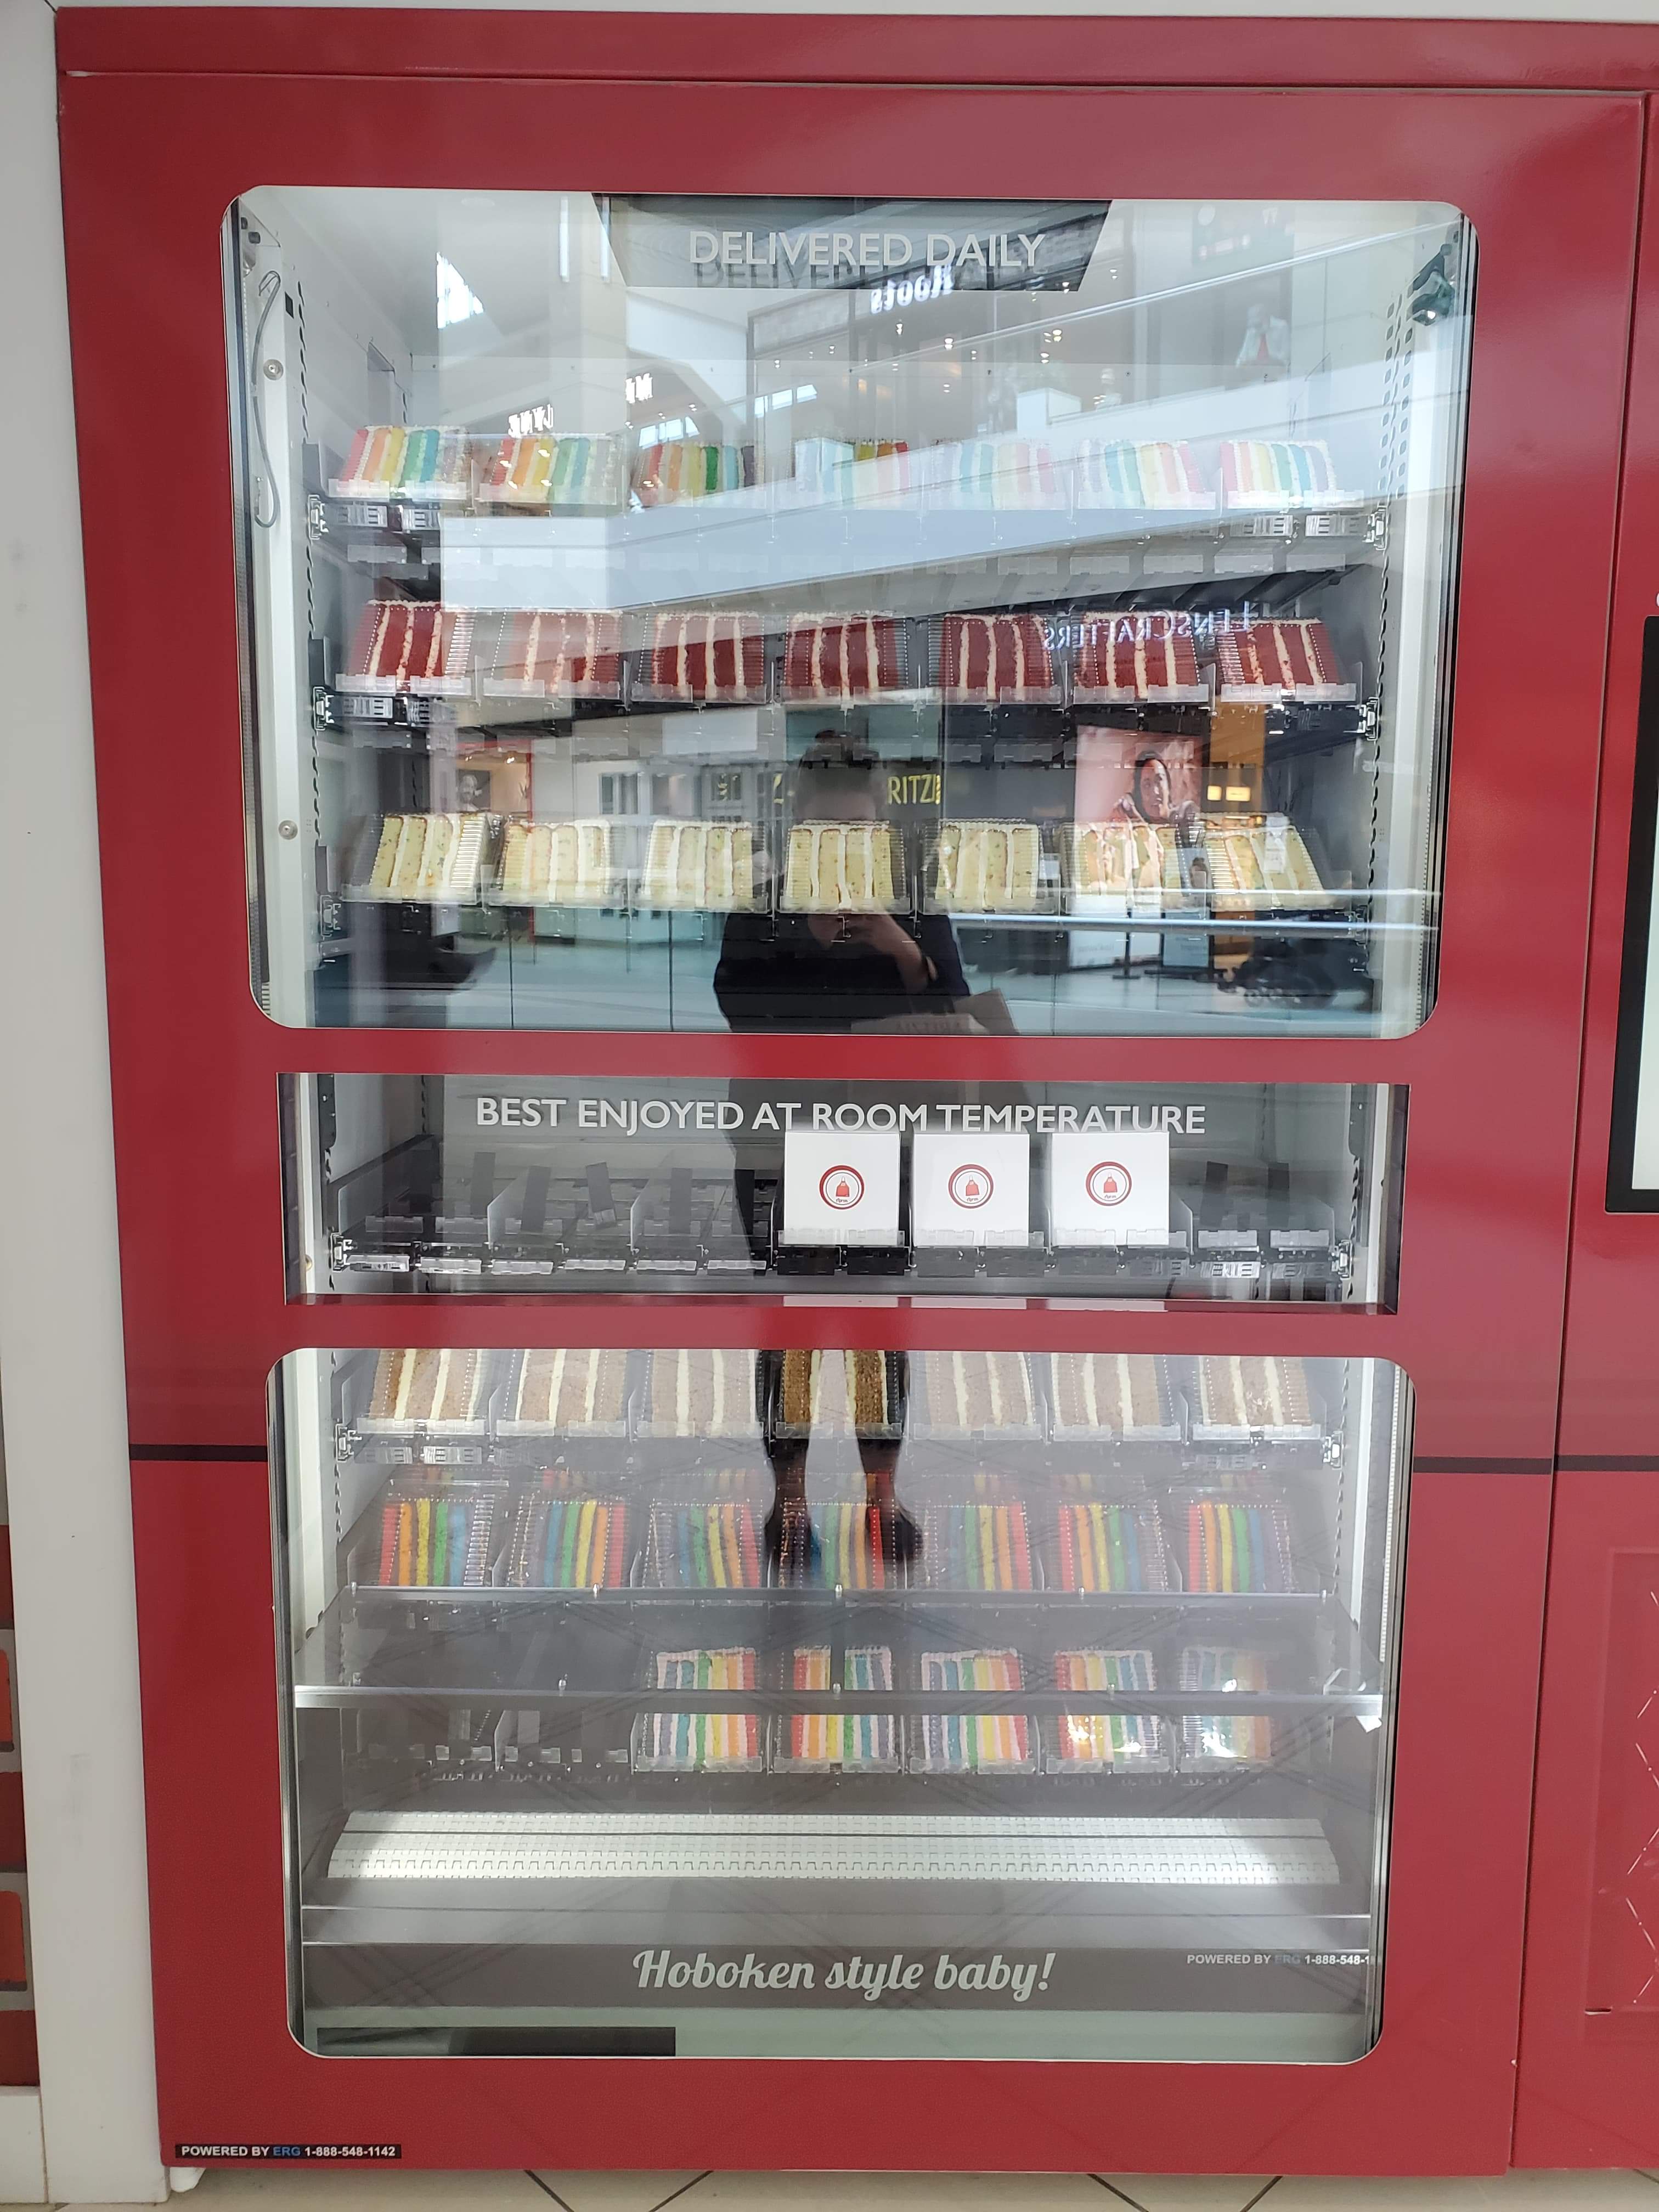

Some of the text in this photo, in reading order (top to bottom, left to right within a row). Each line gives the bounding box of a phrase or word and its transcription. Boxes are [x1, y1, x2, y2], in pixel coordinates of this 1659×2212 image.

[690, 231, 1046, 267] DELIVERED DAILY
[477, 1097, 1206, 1136] BEST ENJOYED AT ROOM TEMPERATURE
[632, 1950, 1057, 2002] Hoboken style baby!
[1187, 1954, 1251, 1965] POWERED
[1254, 1954, 1272, 1965] BY
[1274, 1954, 1301, 1965] ERG
[181, 2146, 396, 2157] POWERED BY ERG 1-888-548-1142
